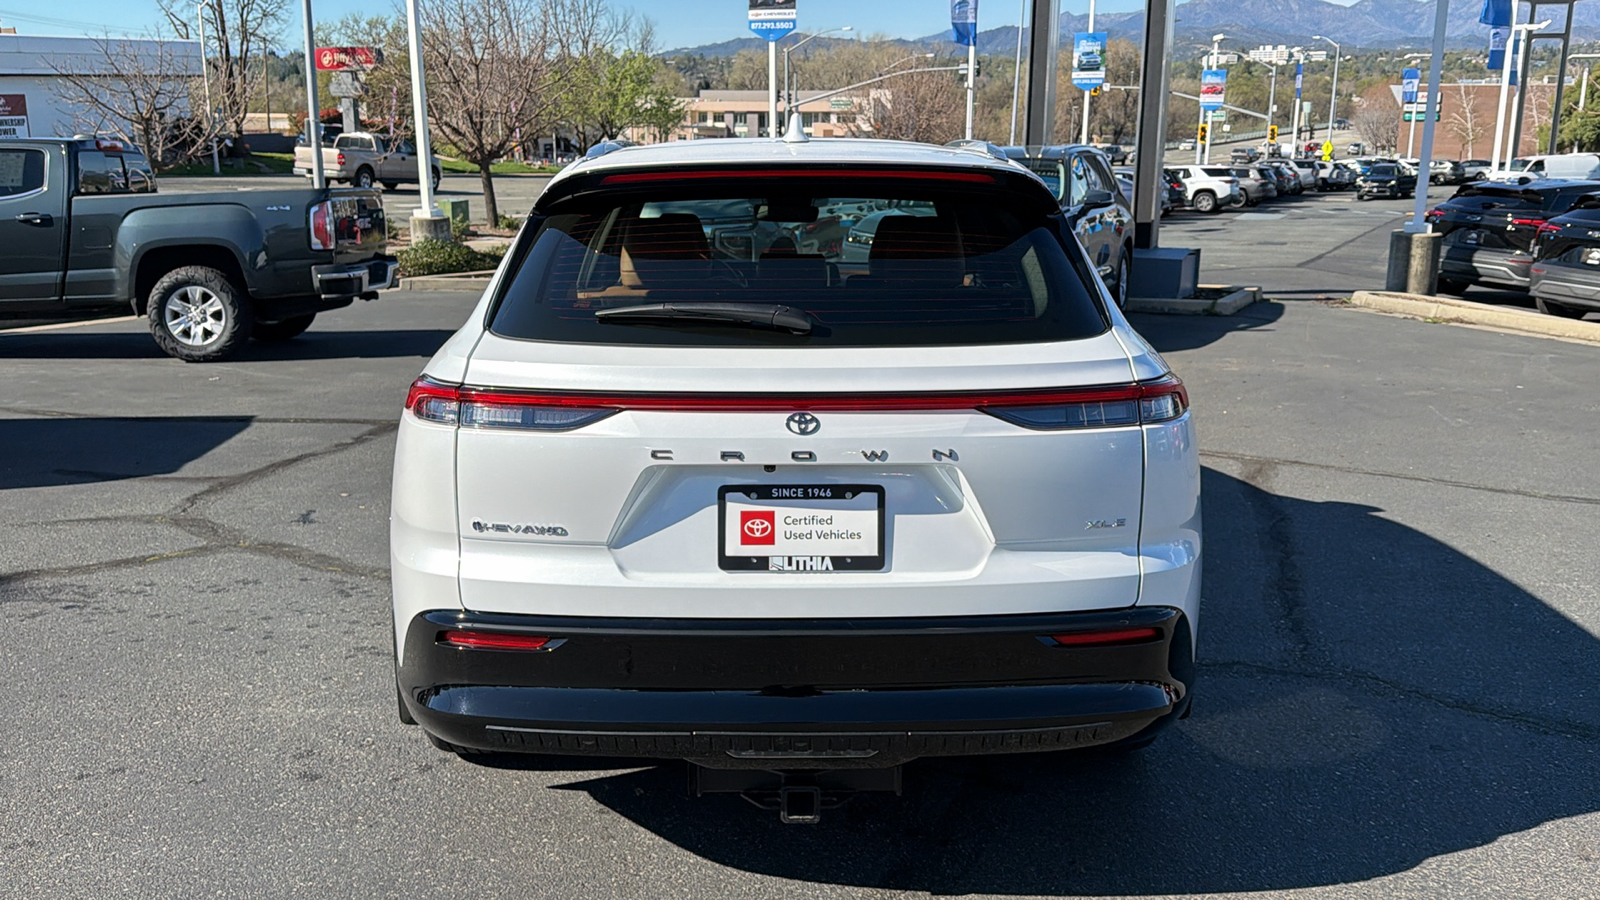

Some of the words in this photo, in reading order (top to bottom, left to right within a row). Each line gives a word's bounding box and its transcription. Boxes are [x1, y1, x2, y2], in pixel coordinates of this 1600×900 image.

[650, 448, 959, 462] CROWN
[771, 488, 804, 498] SINCE
[807, 488, 832, 498] 1946
[783, 515, 833, 526] Certified
[1083, 518, 1127, 531] XLE
[783, 530, 813, 540] Used
[815, 529, 862, 540] Vehicles
[783, 556, 834, 571] LITHIA
